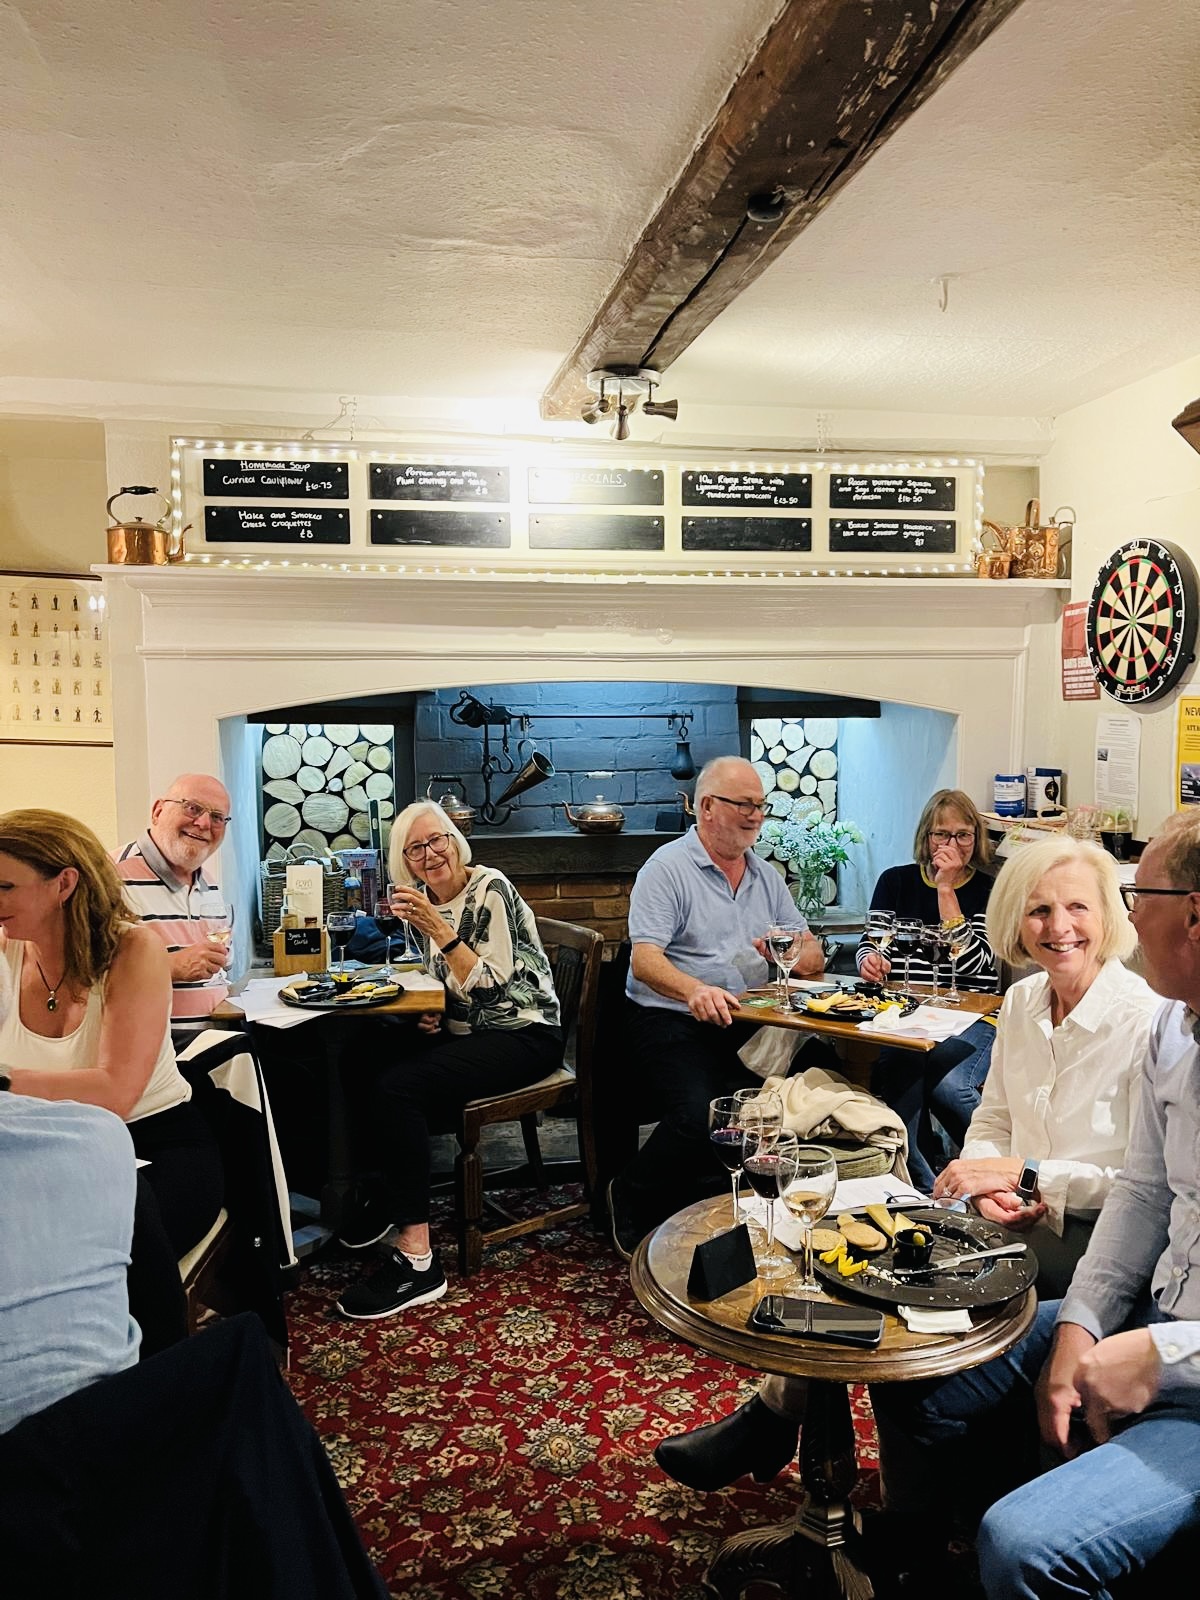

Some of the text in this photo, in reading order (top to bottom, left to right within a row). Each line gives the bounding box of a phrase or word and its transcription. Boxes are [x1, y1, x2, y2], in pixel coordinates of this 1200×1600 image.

[240, 460, 311, 472] Homemade Soup
[222, 475, 255, 485] Curried
[260, 475, 303, 487] Cauliflower
[290, 511, 322, 520] Smoked
[300, 528, 314, 539] £8
